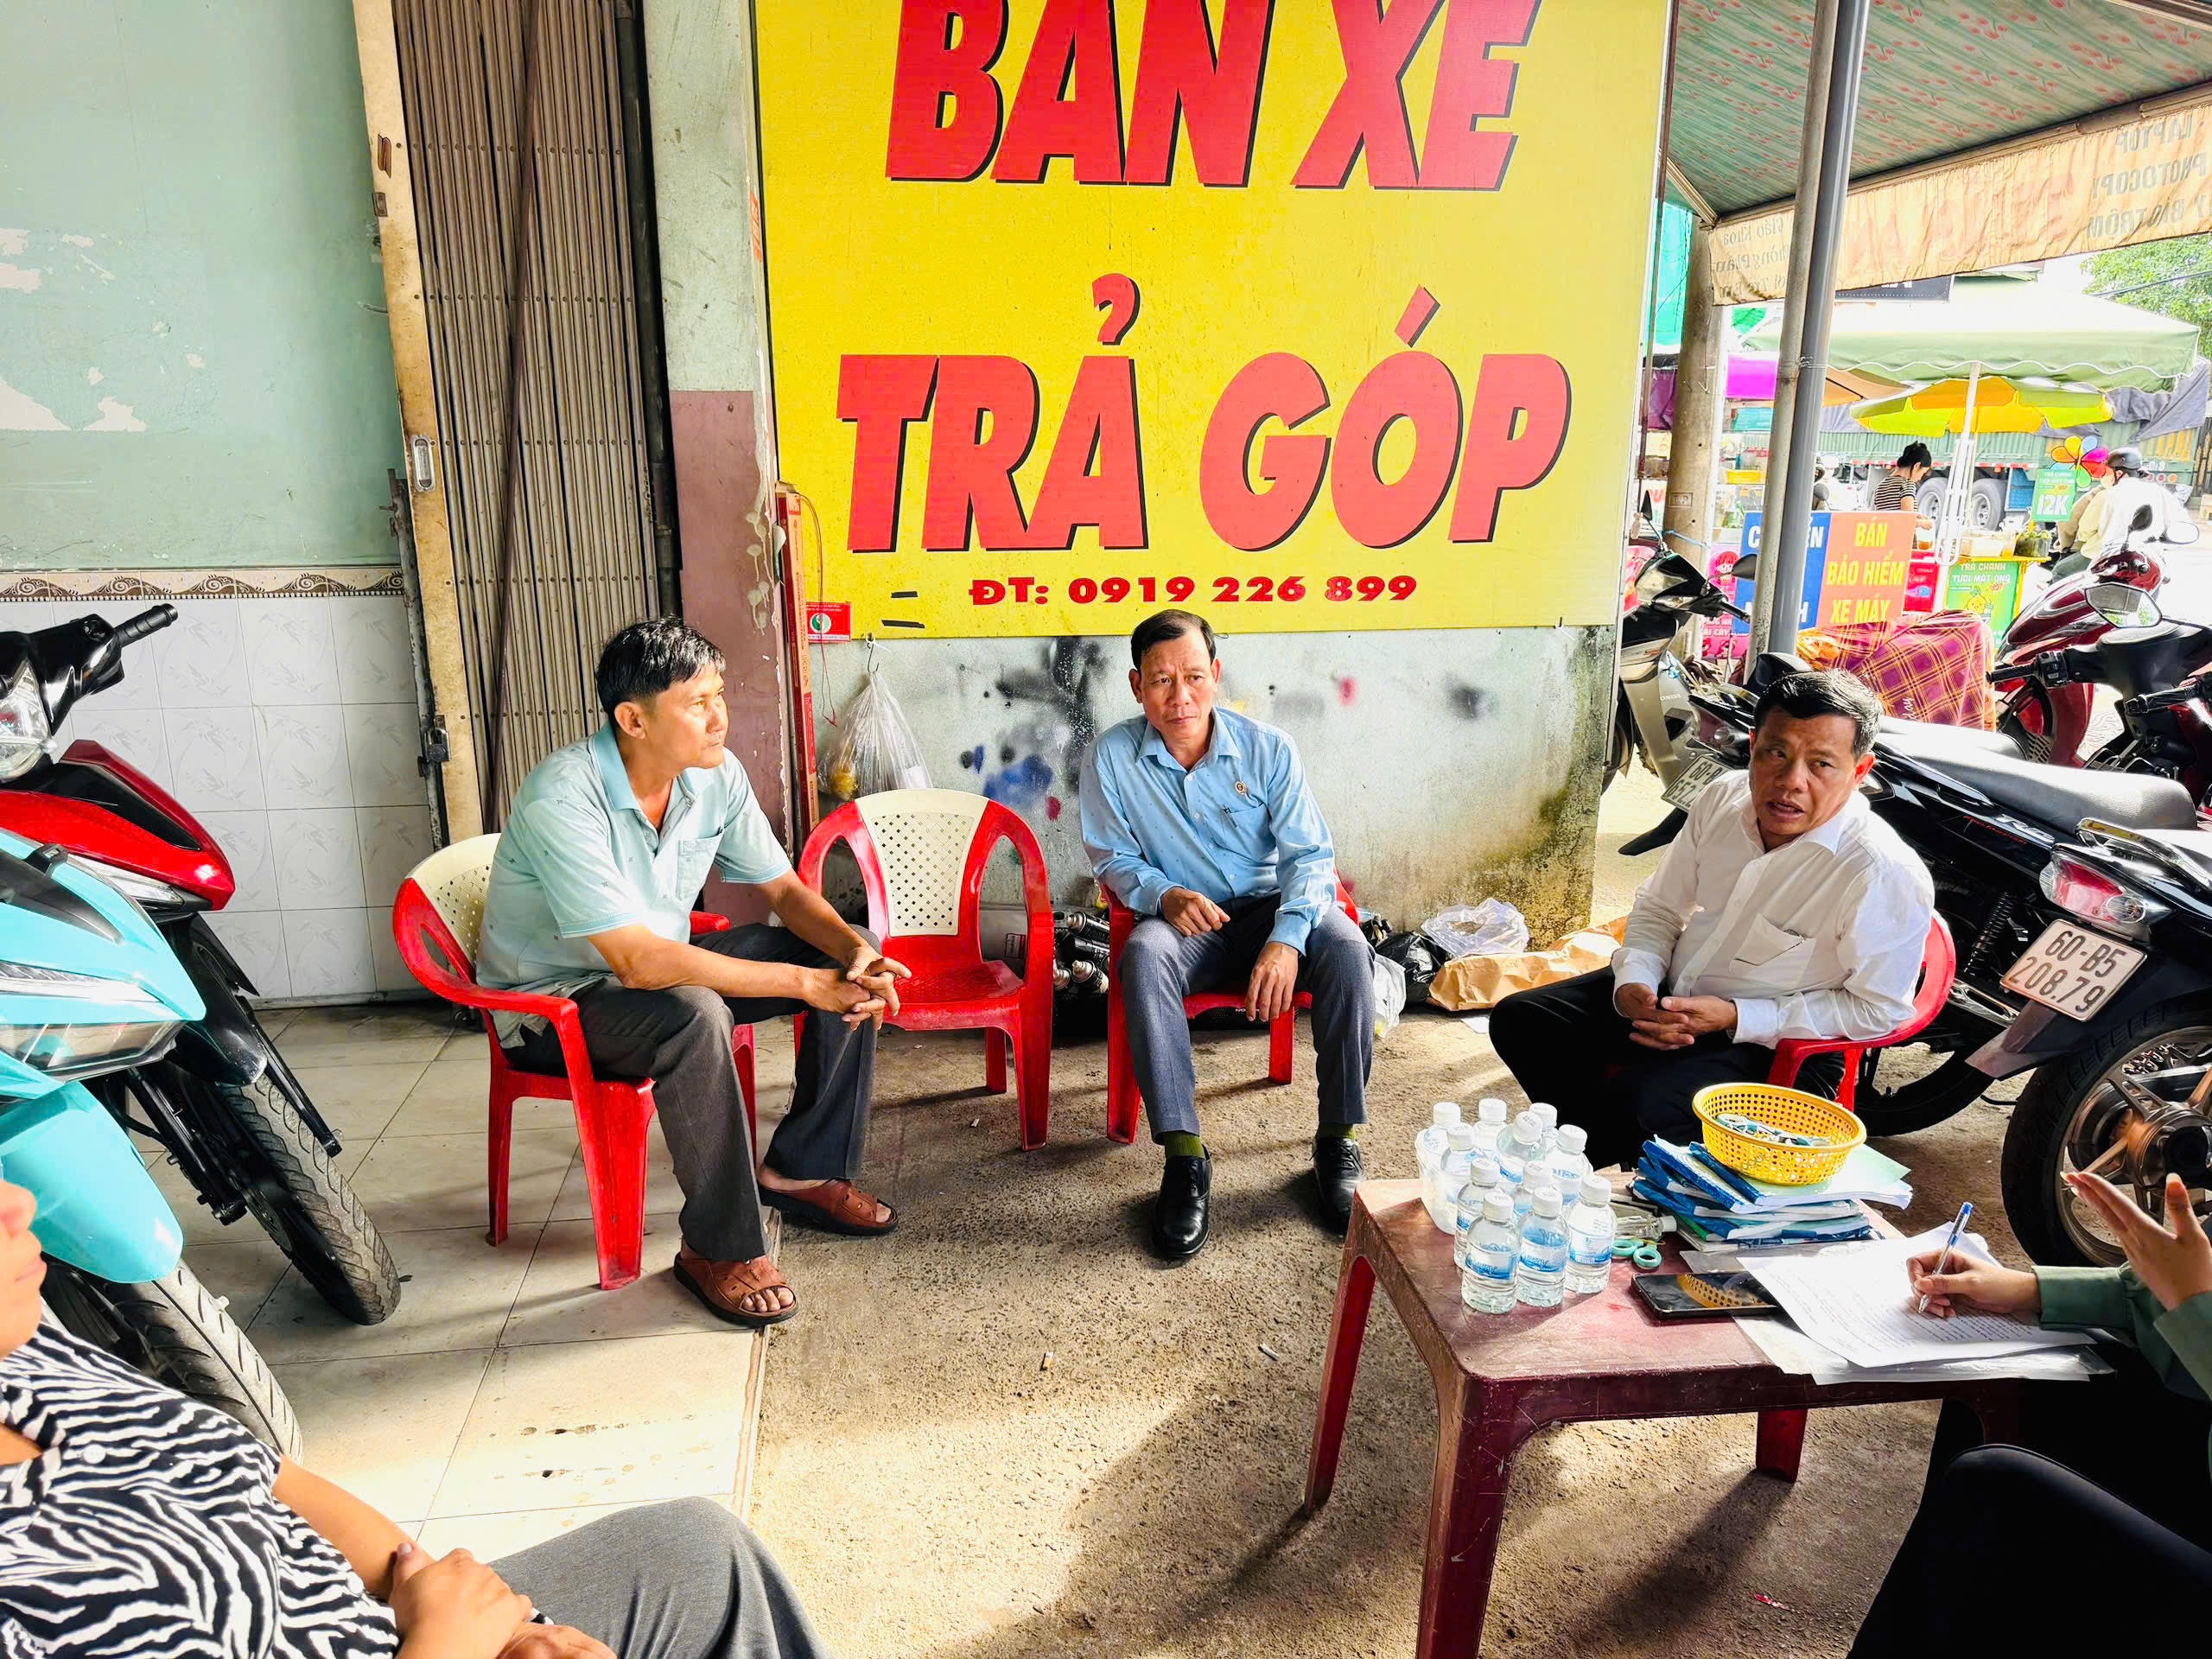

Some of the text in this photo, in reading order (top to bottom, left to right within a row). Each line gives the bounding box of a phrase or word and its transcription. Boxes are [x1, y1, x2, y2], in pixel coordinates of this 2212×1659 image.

[1291, 0, 1541, 191] XE
[836, 273, 1573, 553] TRẢ GÓP
[2036, 493, 2070, 517] 12K
[1854, 517, 1888, 547] BÁN
[1826, 554, 1859, 587] BẢO
[1863, 550, 1907, 587] HIỂM
[968, 575, 1418, 606] ĐT: 0919 226 899
[1830, 599, 1851, 624] XE
[1854, 594, 1891, 623] MÁY
[1659, 693, 1681, 702] ONDA
[1688, 760, 1724, 786] 60-B
[2044, 930, 2127, 978] 60-B5
[2008, 956, 2107, 1013] 208.79
